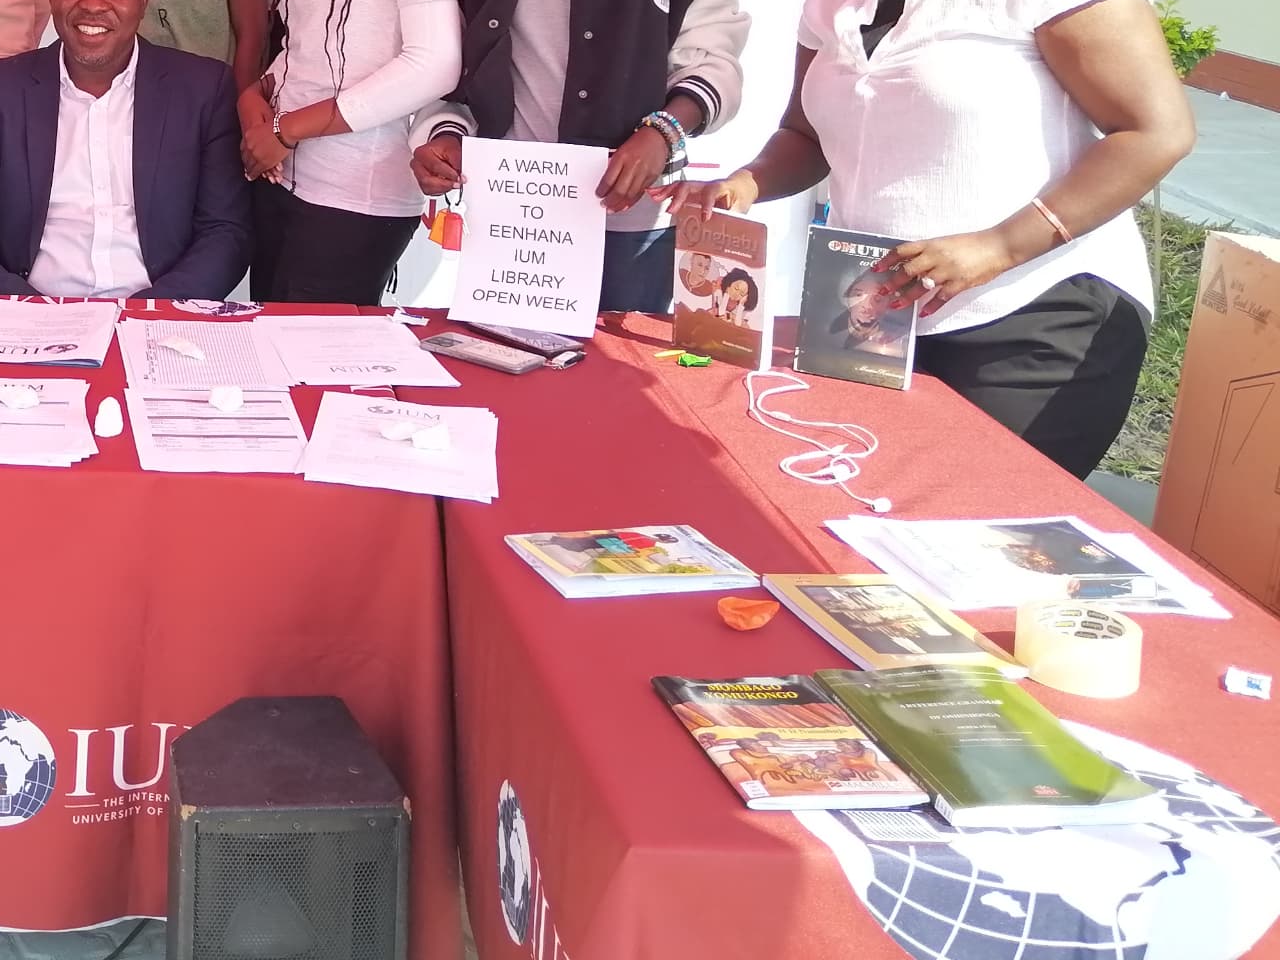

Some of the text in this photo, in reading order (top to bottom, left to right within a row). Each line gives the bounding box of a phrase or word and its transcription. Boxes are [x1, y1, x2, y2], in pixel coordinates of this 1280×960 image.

[498, 158, 568, 176] A WARM
[487, 179, 578, 199] WELCOME
[520, 205, 544, 219] TO
[489, 224, 574, 245] EENHANA
[514, 248, 545, 265] IUM
[491, 269, 565, 289] LIBRARY
[472, 289, 578, 311] OPEN WEEK
[65, 722, 193, 797] IU
[103, 791, 170, 808] THE INTERN
[72, 806, 164, 824] UNIVERSITY OF
